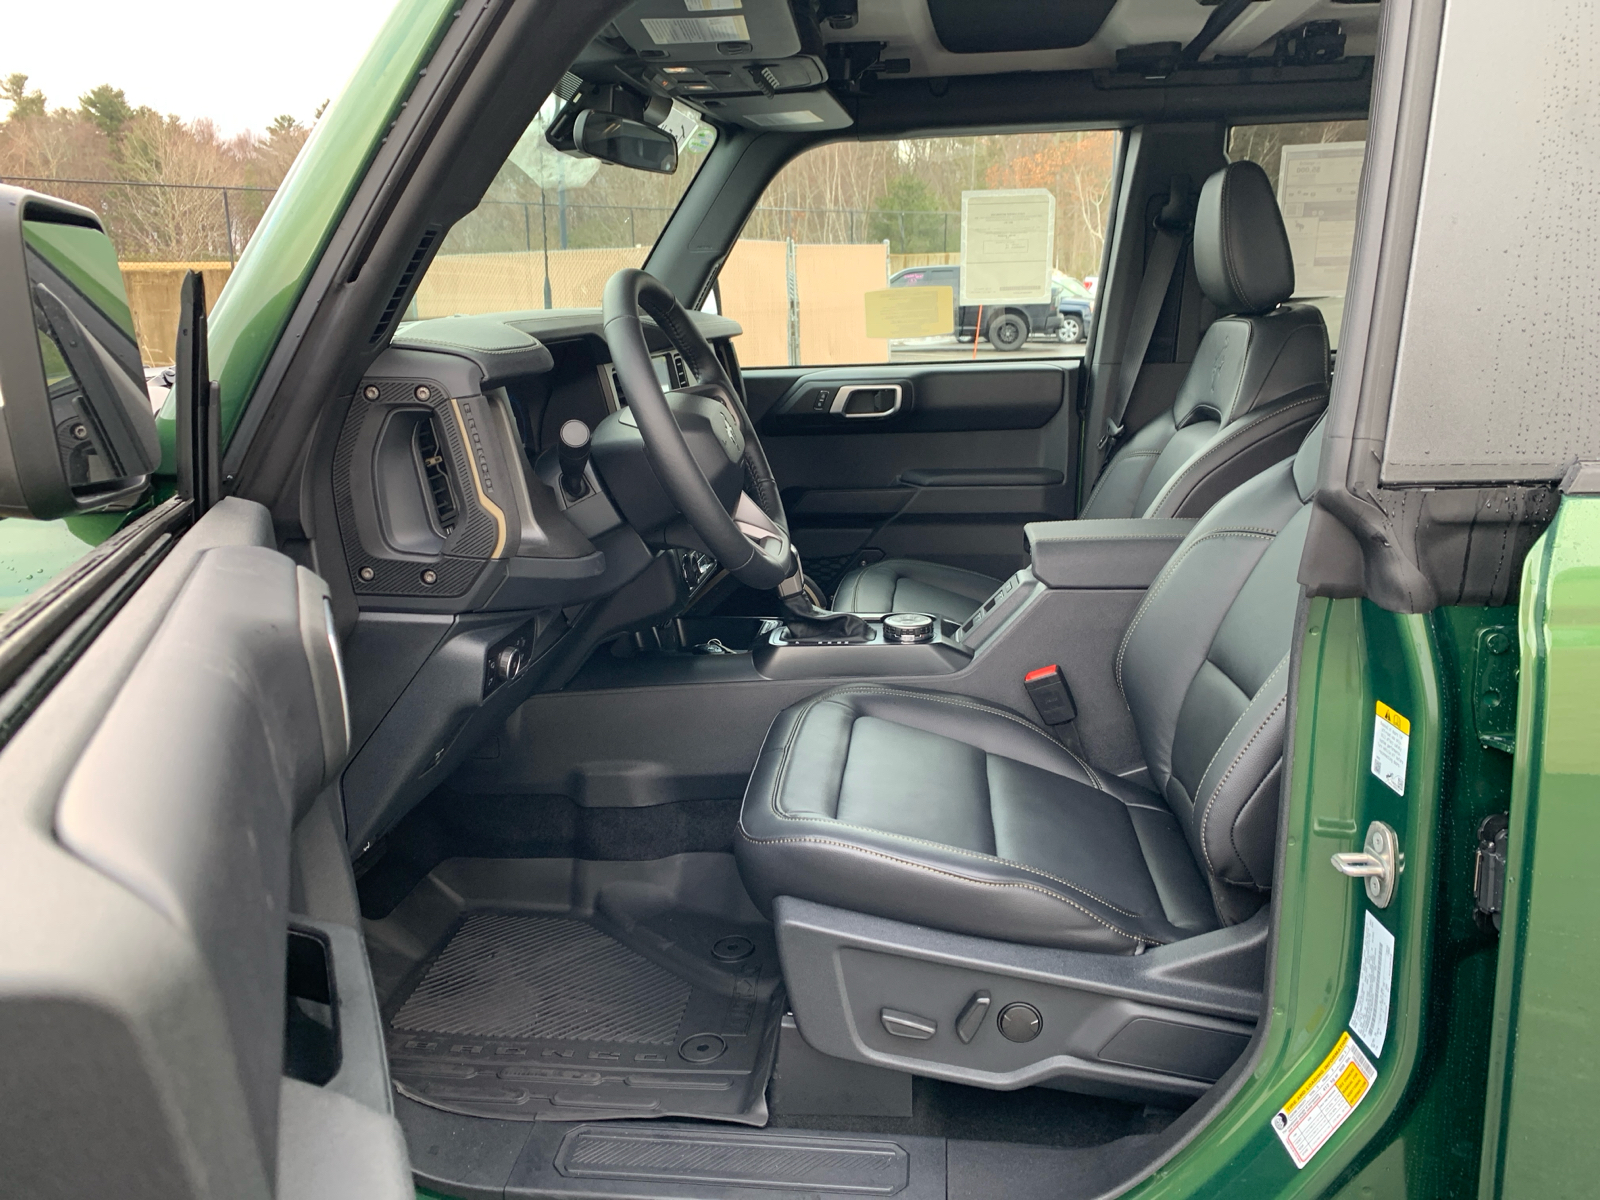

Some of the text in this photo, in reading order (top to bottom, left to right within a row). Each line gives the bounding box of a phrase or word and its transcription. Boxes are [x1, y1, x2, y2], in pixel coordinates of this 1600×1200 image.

[462, 402, 494, 494] BRONCO
[404, 1040, 668, 1062] BRONCO
[1305, 1069, 1325, 1091] LOADING
[1323, 1035, 1349, 1071] INFORMATION
